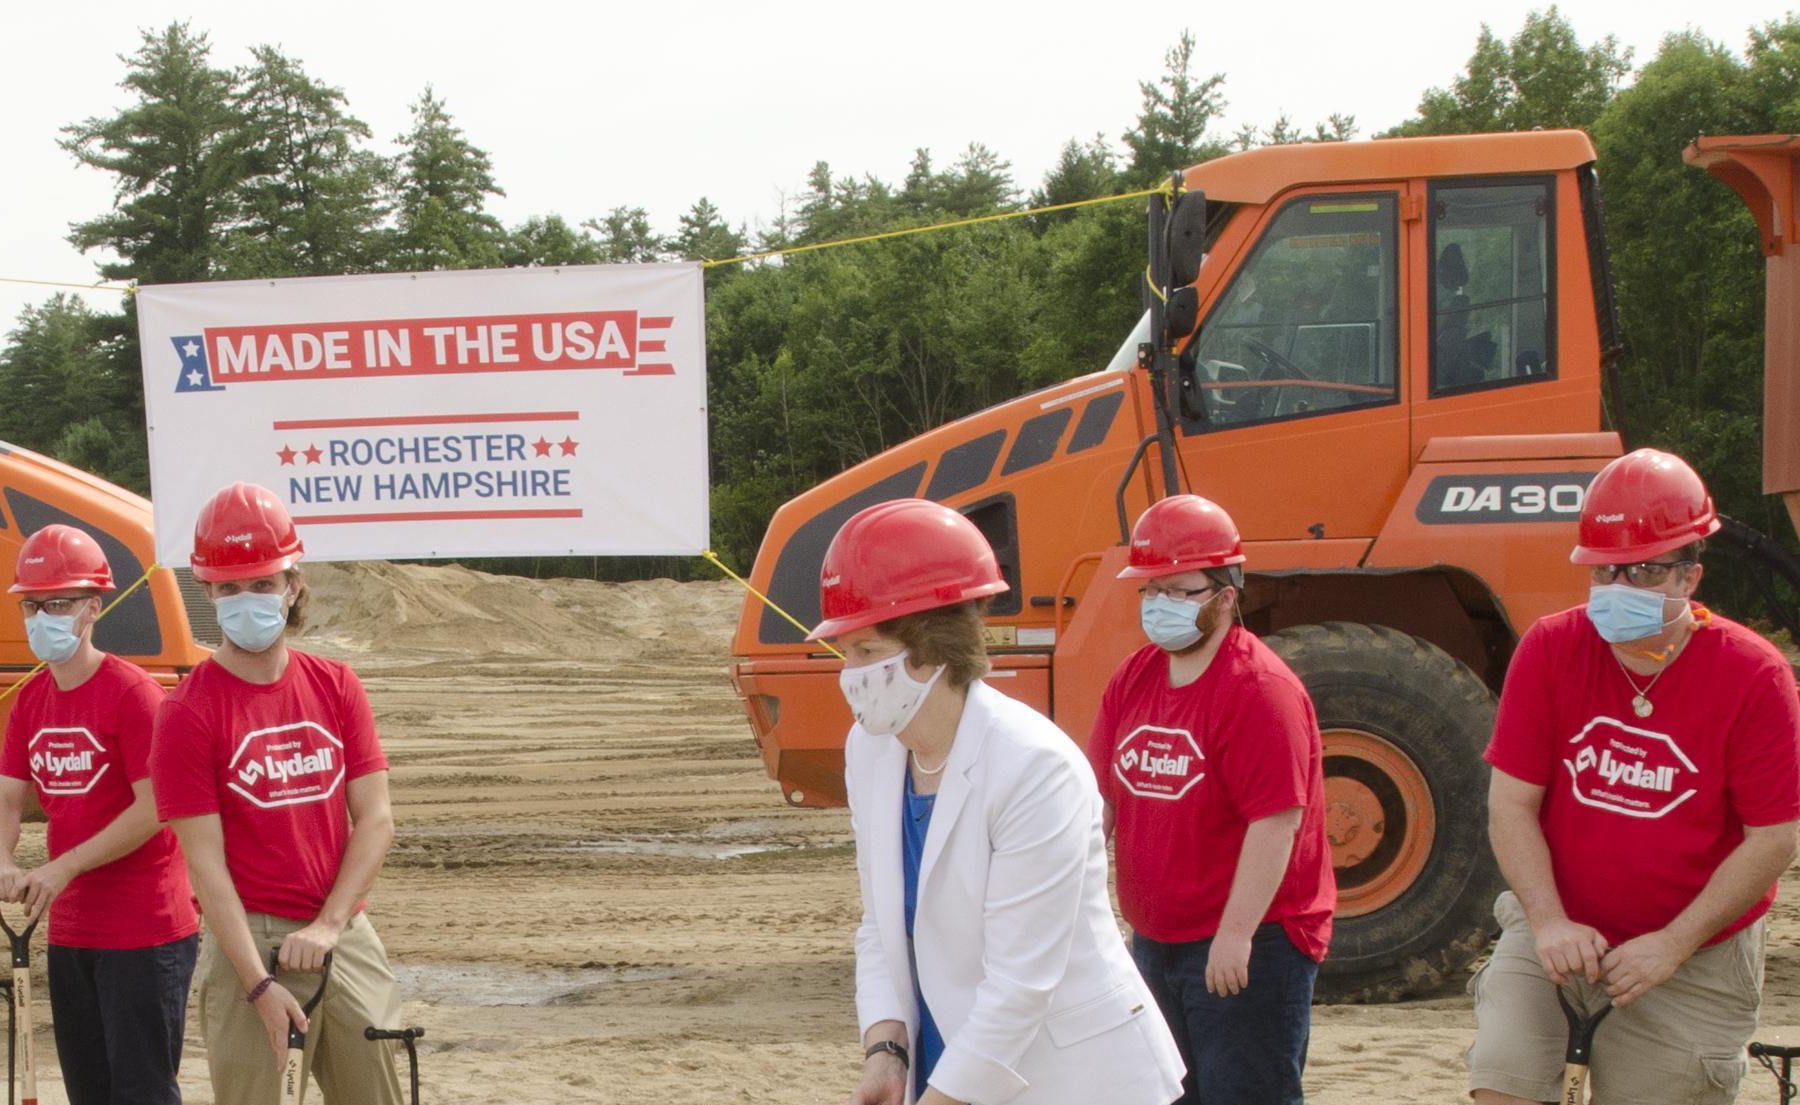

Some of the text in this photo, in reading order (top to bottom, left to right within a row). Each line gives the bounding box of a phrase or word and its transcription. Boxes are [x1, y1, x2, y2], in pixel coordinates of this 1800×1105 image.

[215, 320, 630, 374] MADE IN THE USA
[329, 433, 526, 466] ROCHESTER
[289, 469, 571, 504] NEW HAMPSHIRE
[45, 750, 93, 777] Lydall
[264, 747, 333, 784] Lydall
[1140, 749, 1190, 778] Lydall
[1598, 748, 1675, 792] Lydall
[284, 1068, 295, 1095] Lydall
